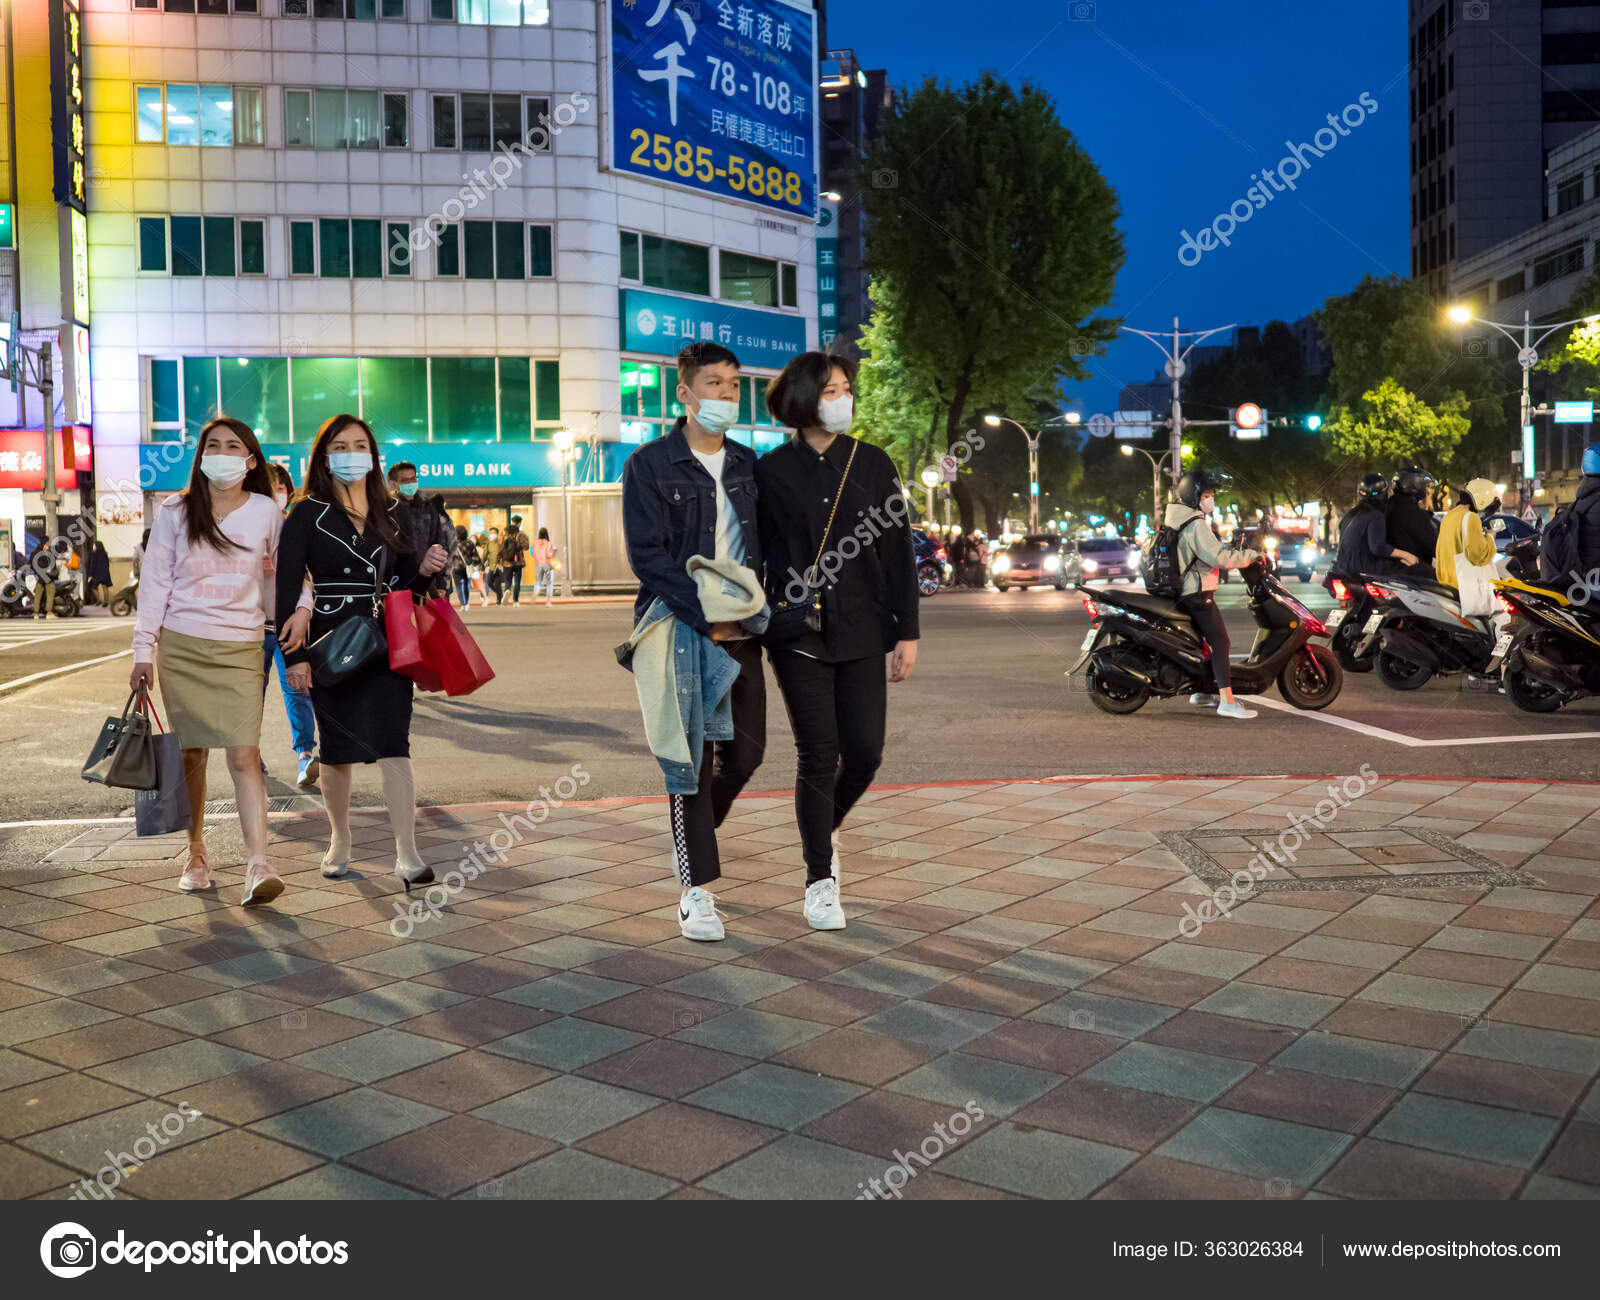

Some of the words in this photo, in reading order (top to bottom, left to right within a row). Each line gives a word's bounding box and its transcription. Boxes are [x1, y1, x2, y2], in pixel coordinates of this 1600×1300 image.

[717, 0, 792, 52] 全新落成
[710, 108, 806, 158] 民權捷運站出口
[630, 128, 802, 206] 2585-5888
[820, 250, 836, 344] 玉山銀行
[662, 314, 732, 344] 玉山銀行
[737, 336, 767, 349] E.SUN
[771, 341, 798, 353] BANK
[464, 463, 512, 476] BANK
